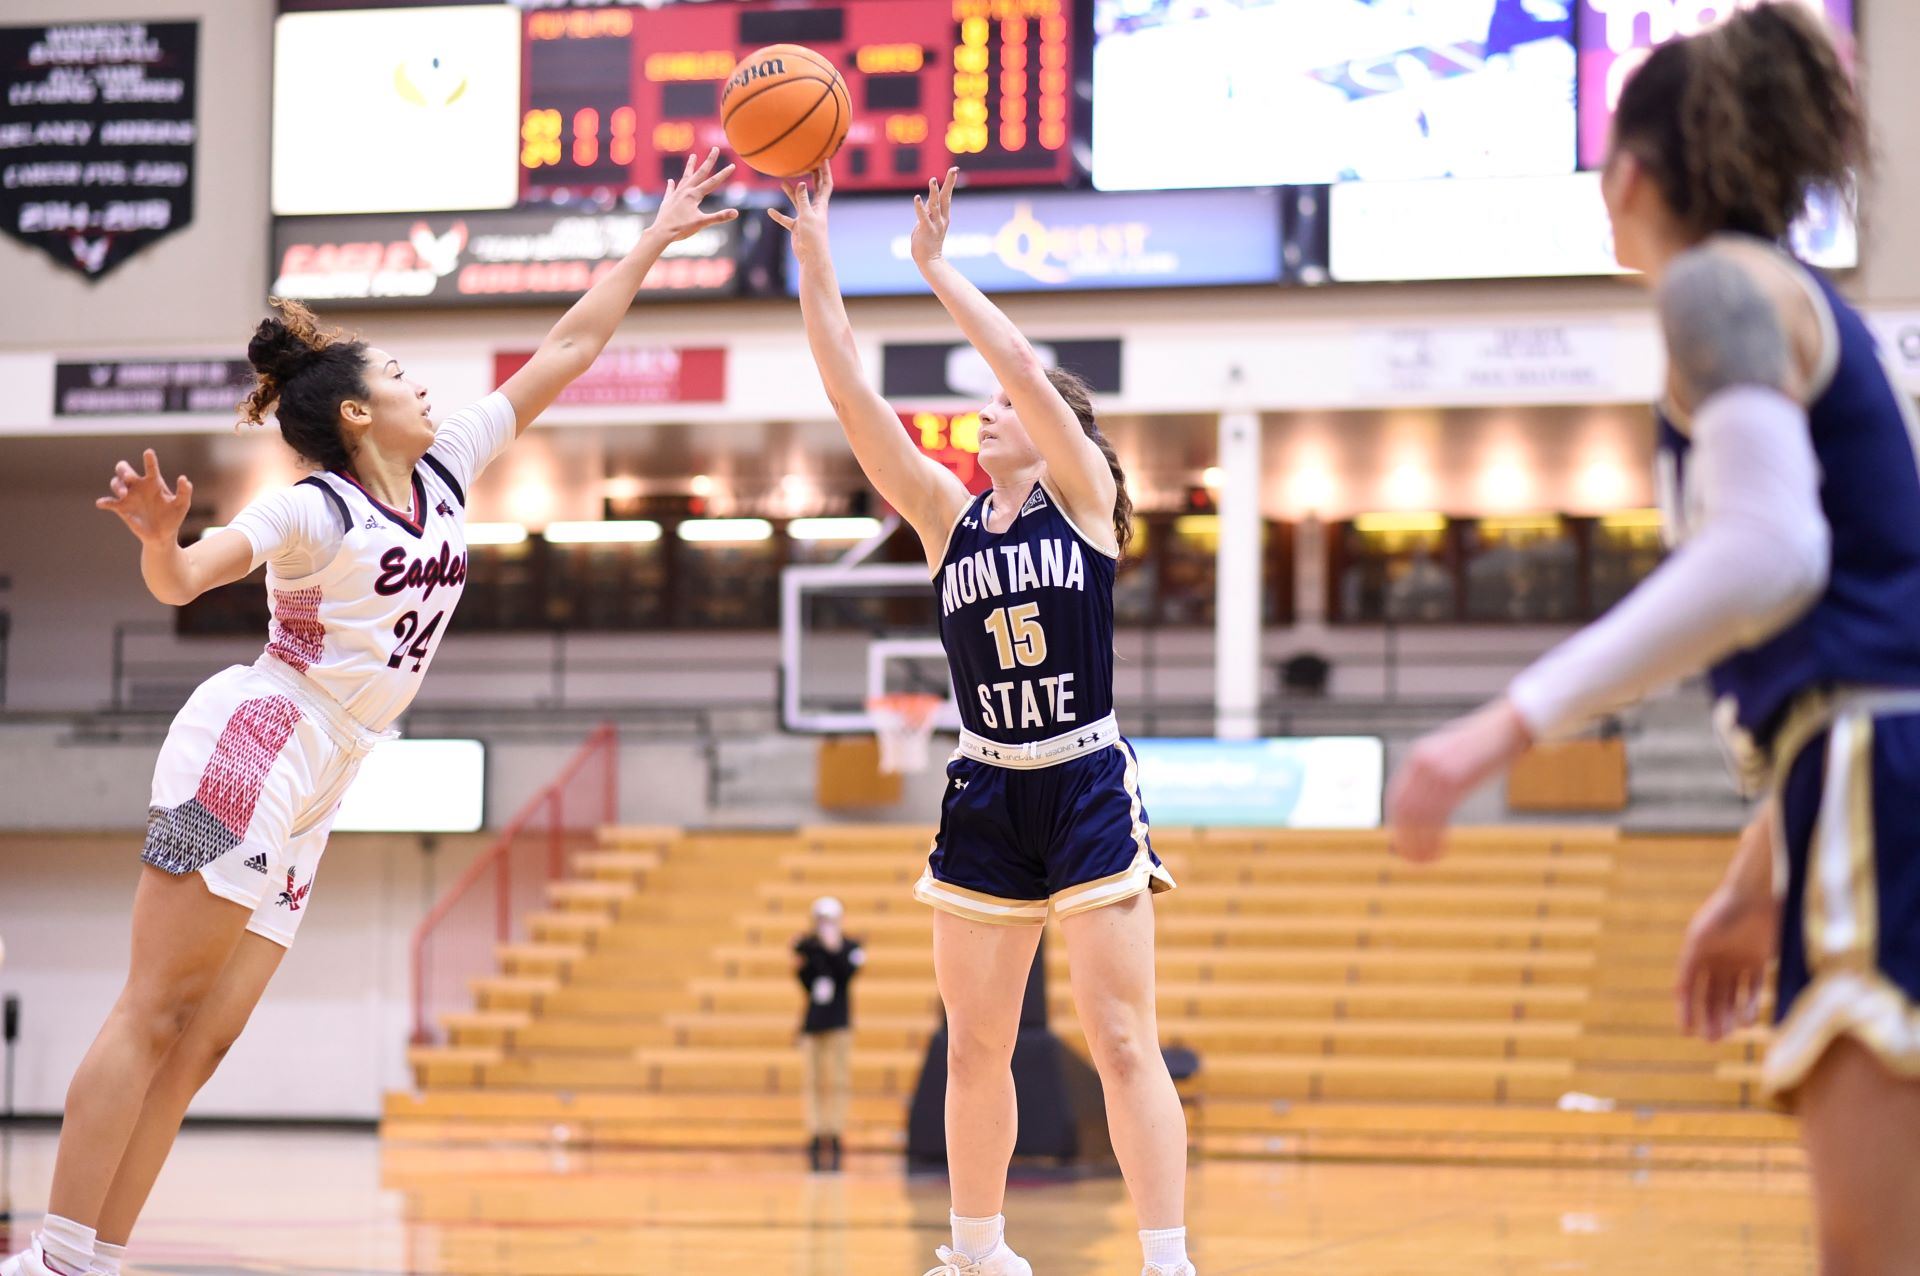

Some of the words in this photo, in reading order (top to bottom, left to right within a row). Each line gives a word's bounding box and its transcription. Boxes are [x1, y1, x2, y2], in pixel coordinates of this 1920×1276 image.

[374, 540, 466, 602] Eagles
[942, 538, 1085, 617] MONTANA
[387, 610, 444, 673] 24
[984, 601, 1048, 670] 15
[977, 672, 1076, 729] STATE
